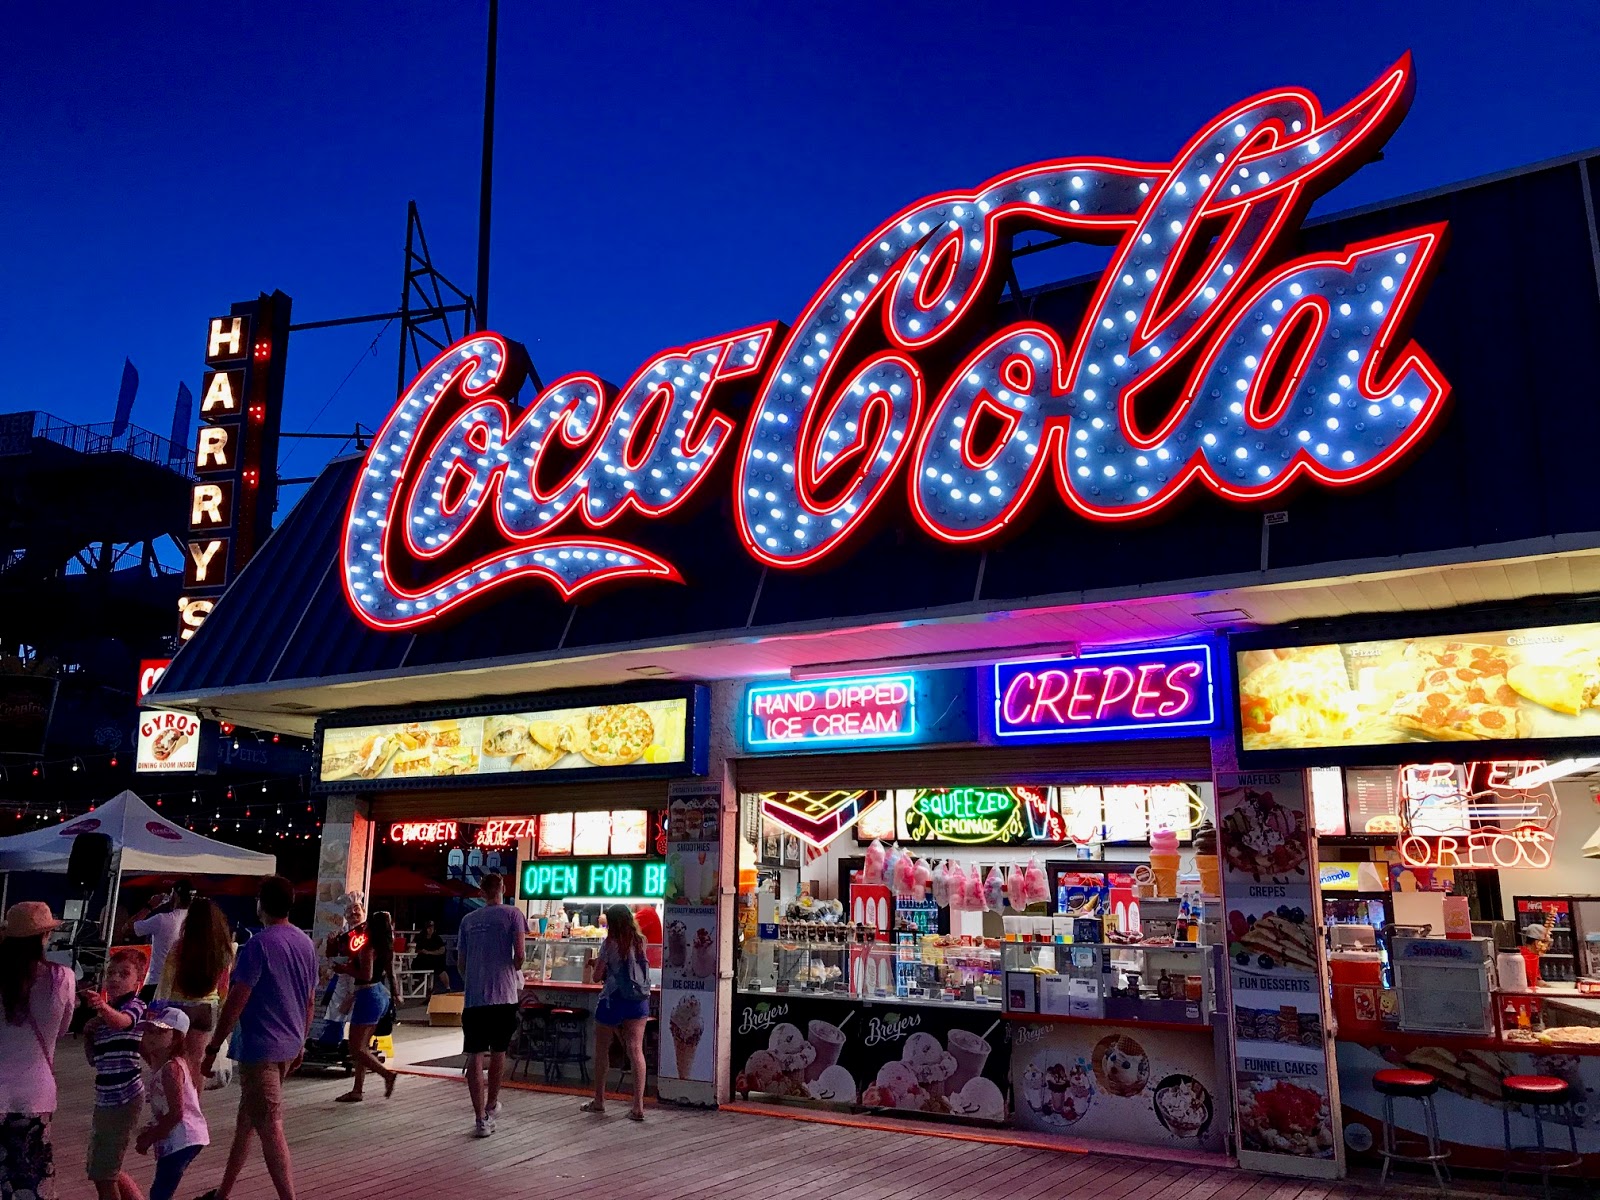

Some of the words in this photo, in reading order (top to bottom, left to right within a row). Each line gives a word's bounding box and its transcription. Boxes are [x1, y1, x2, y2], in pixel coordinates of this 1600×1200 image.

[1350, 648, 1383, 658] Pizza
[755, 690, 815, 716] HAND
[825, 683, 909, 710] DIPPED
[1002, 660, 1204, 727] CREPES
[141, 713, 198, 737] GYROS
[766, 716, 803, 740] ICE
[812, 709, 899, 737] CREAM
[159, 761, 176, 769] ROOM
[177, 761, 196, 769] INSIDE
[1237, 773, 1281, 786] WAFFLES
[919, 788, 1009, 819] SQUEEZED
[486, 819, 536, 840] PIZZA
[934, 818, 999, 835] LEMONADE
[676, 843, 711, 852] SMOOTHIES
[1402, 833, 1553, 868] OREOS
[525, 864, 578, 895] OPEN
[589, 864, 632, 894] FOR
[1319, 869, 1351, 884] napple
[1249, 886, 1286, 898] CREPES
[688, 907, 716, 915] MILKSHAKES
[672, 980, 684, 989] ICE
[684, 980, 705, 990] CREAM
[1239, 977, 1258, 989] FUN
[1259, 978, 1310, 992] DESSERTS
[738, 1002, 789, 1035] Breyers
[864, 1013, 922, 1047] Breyers
[1015, 1023, 1054, 1046] Breyers
[1244, 1058, 1283, 1073] FUNNEL
[1284, 1060, 1319, 1076] CAKES
